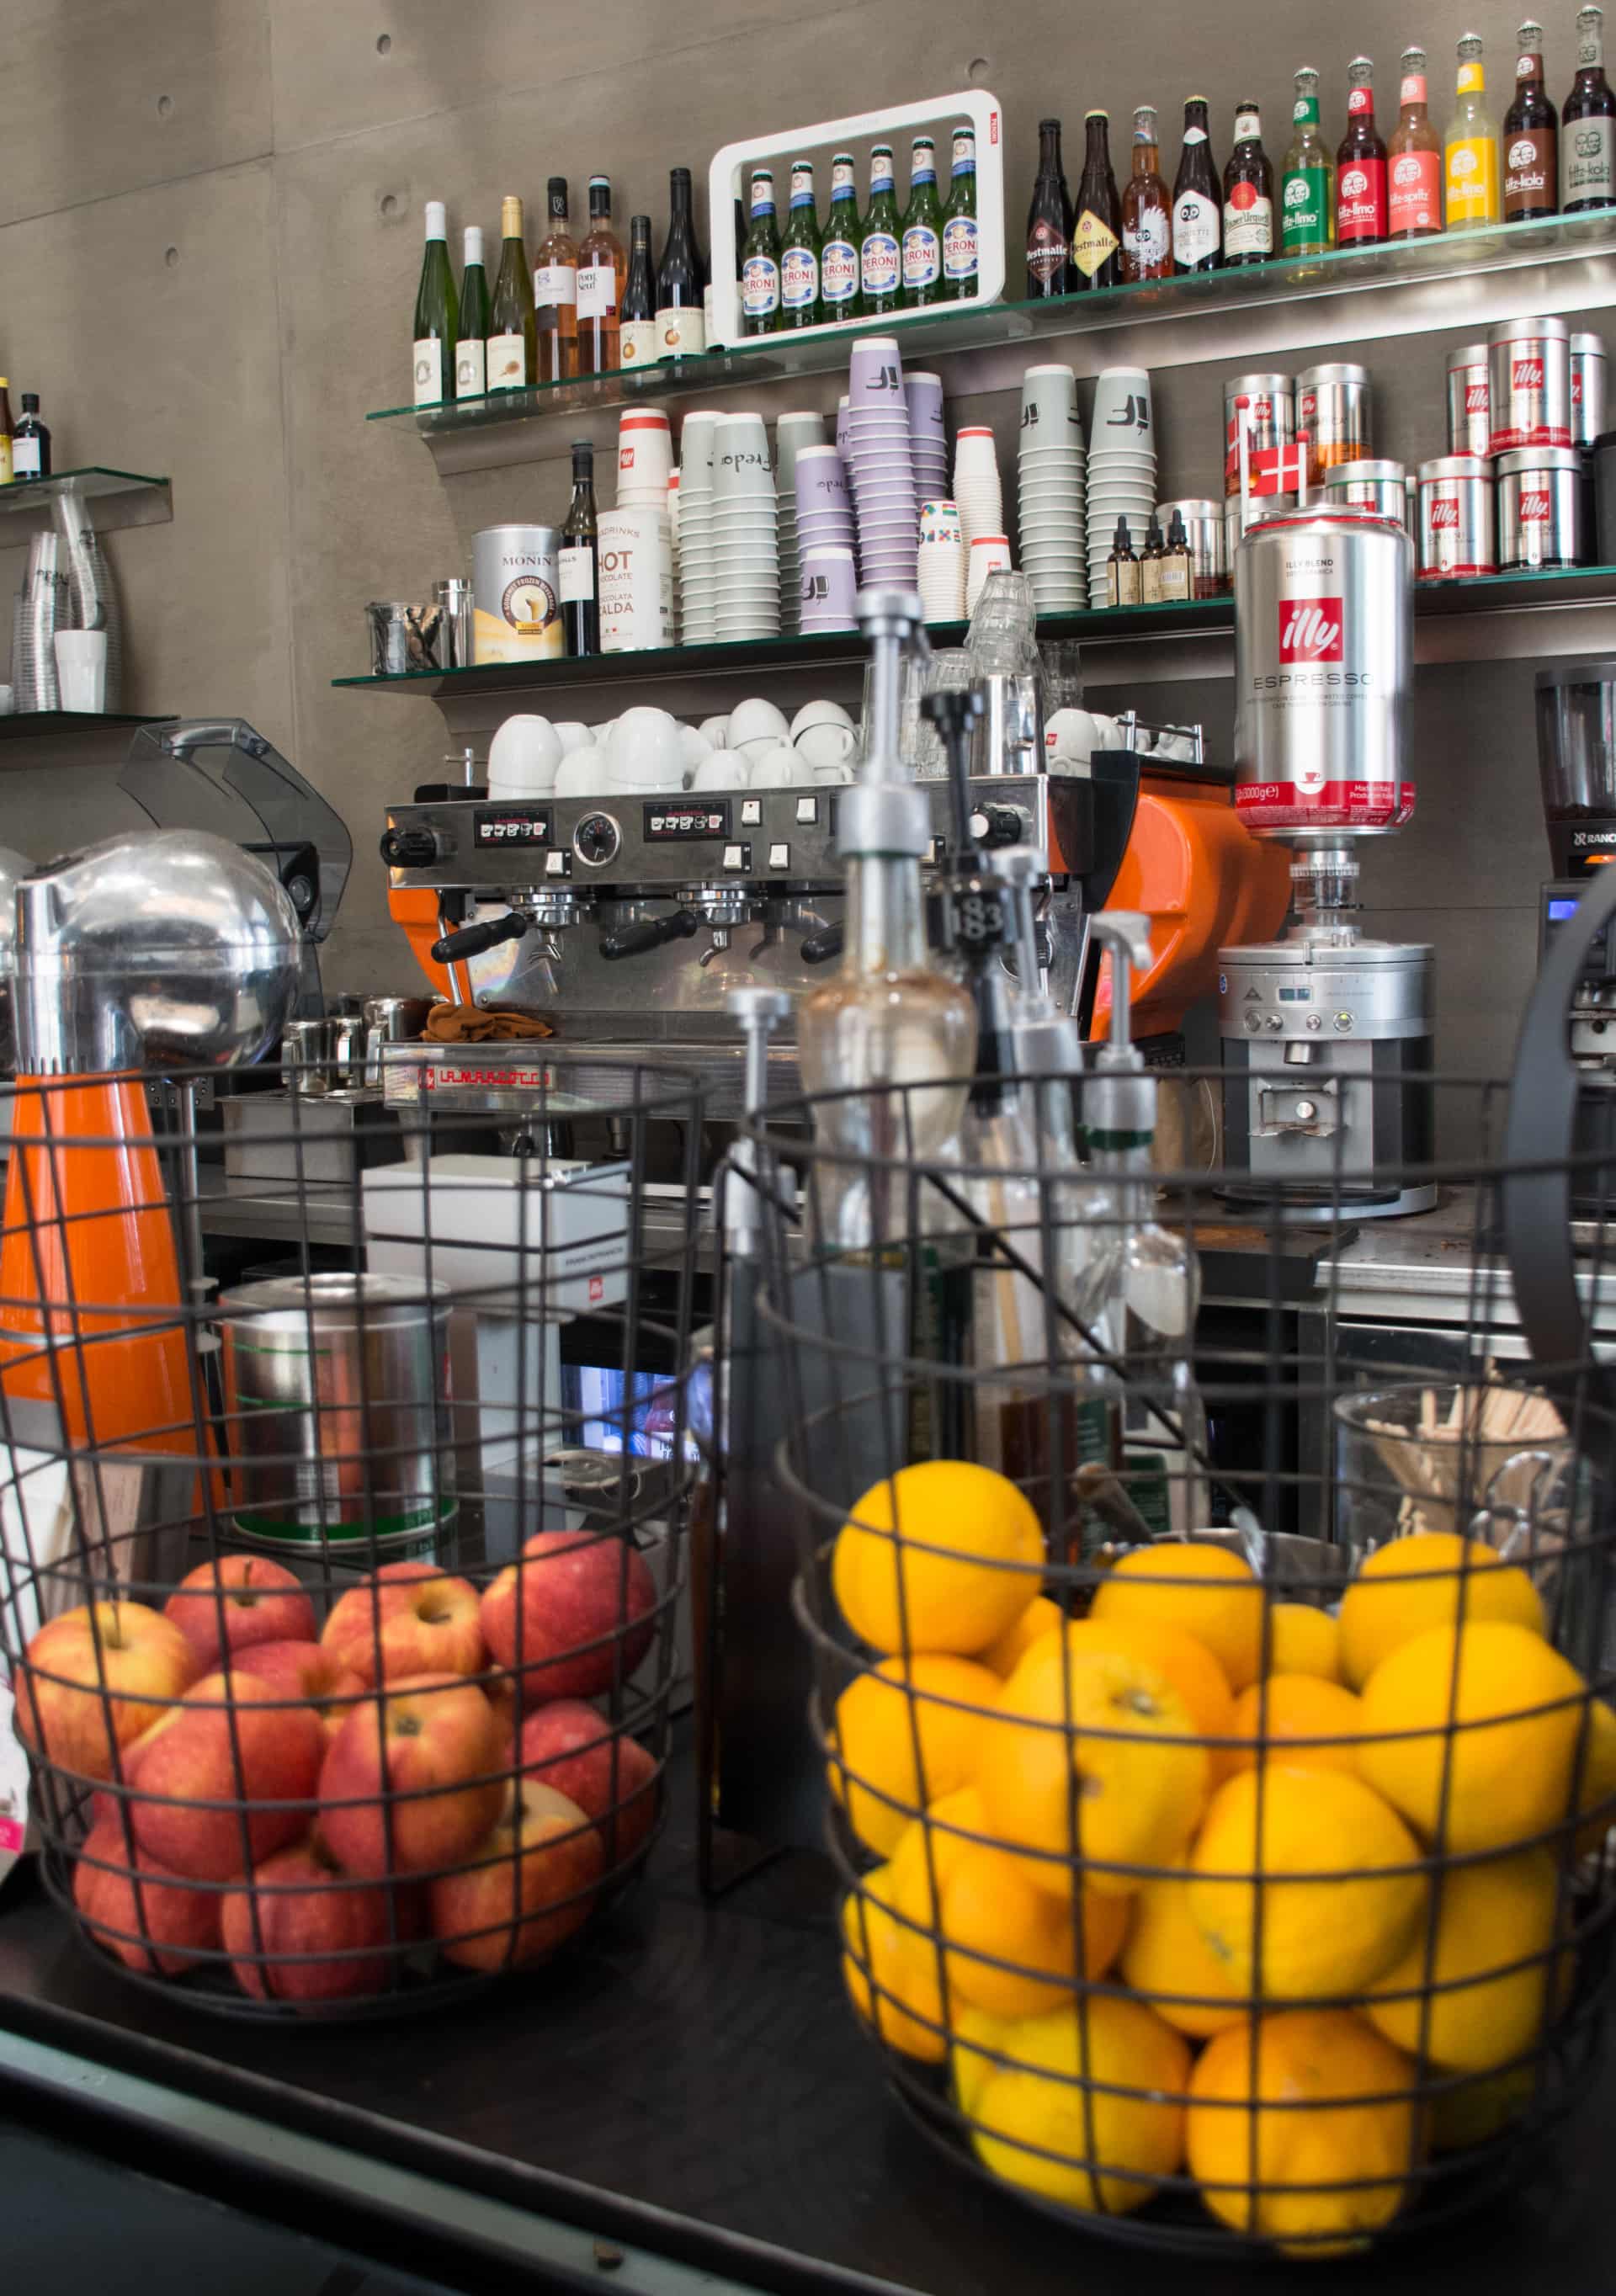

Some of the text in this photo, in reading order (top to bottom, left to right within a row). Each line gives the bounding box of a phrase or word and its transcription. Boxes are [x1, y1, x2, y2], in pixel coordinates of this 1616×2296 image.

[1076, 237, 1114, 252] estmalle
[1027, 245, 1067, 261] estmalle
[862, 256, 897, 269] PERONI
[1515, 363, 1542, 387] illy
[1433, 503, 1457, 526] illy
[1521, 495, 1548, 519] illy
[502, 556, 552, 567] MONIN
[1283, 607, 1338, 657] illy
[1254, 673, 1374, 689] ESPRESSO
